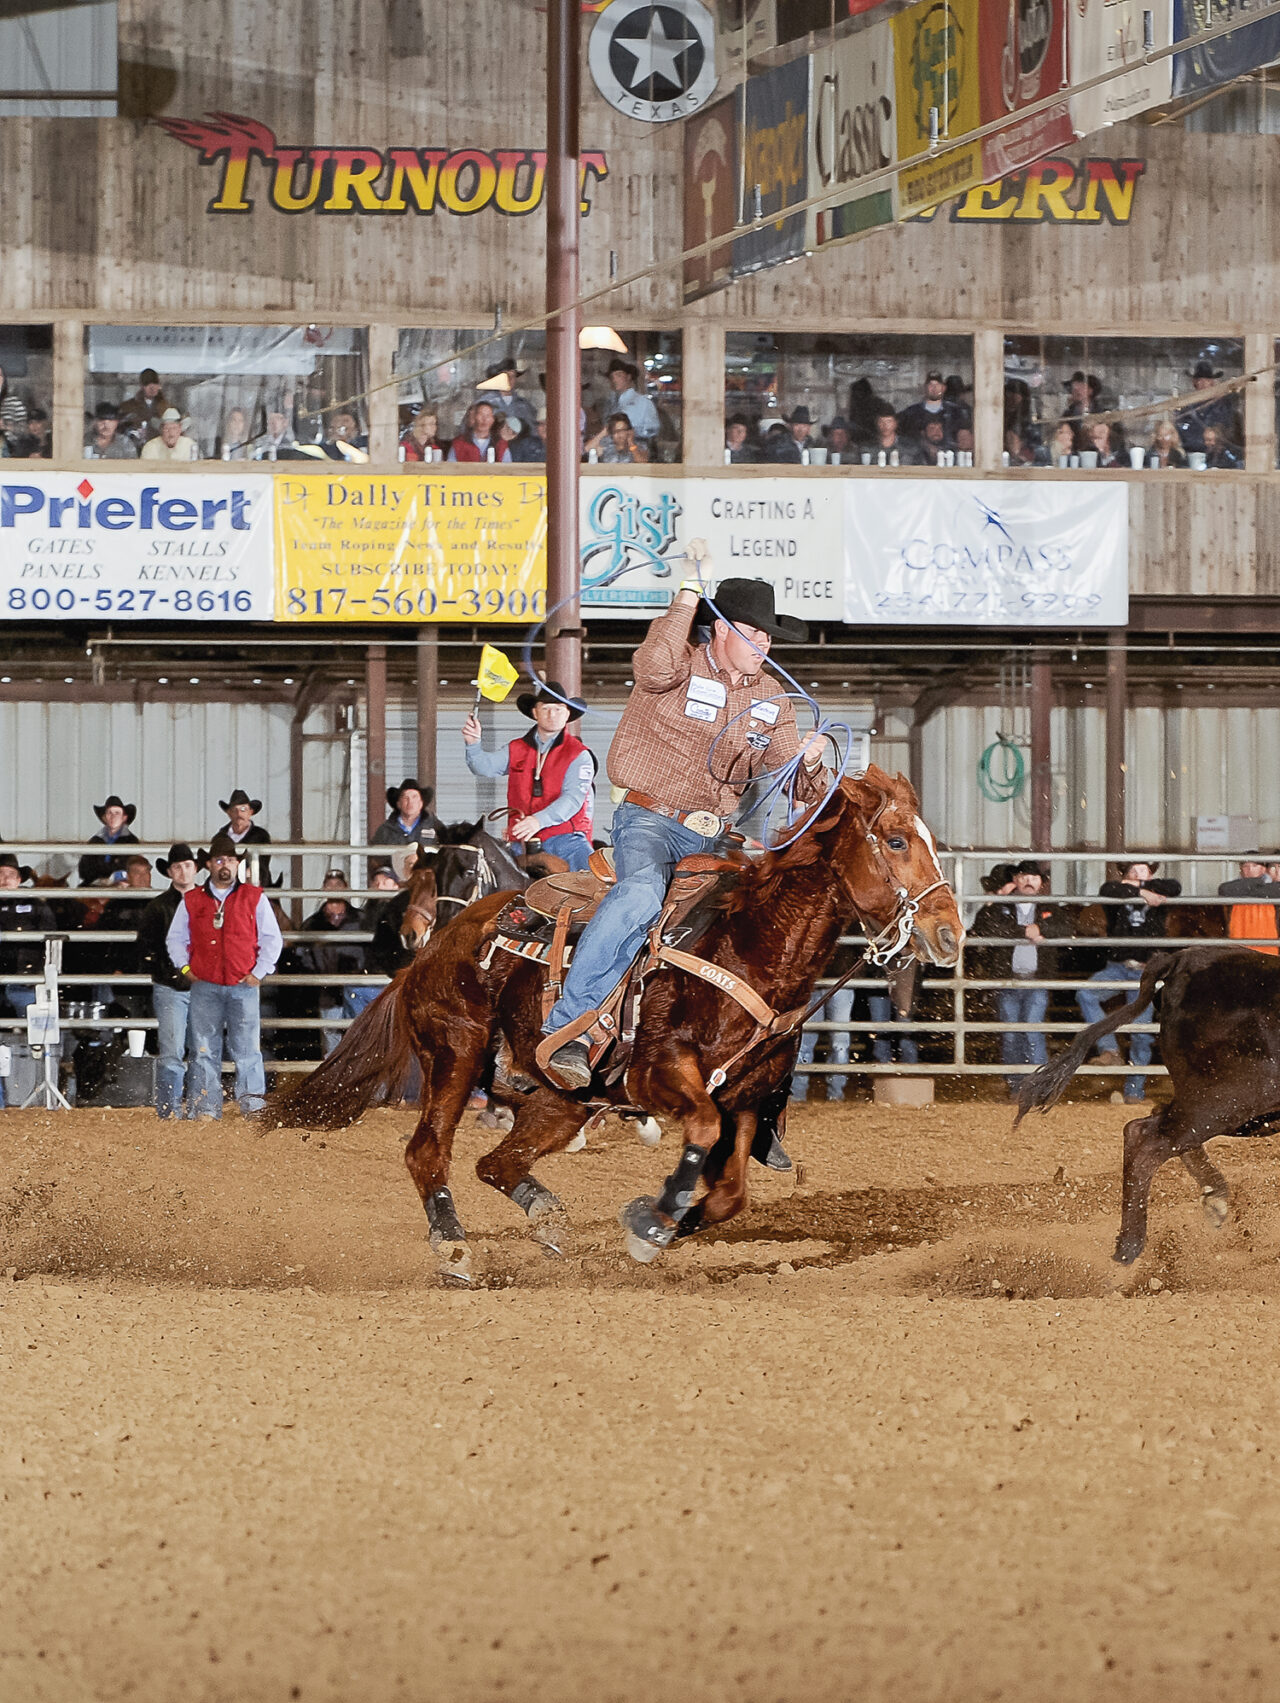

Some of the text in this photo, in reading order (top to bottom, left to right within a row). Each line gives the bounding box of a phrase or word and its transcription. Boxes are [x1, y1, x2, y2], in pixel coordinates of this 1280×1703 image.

[616, 91, 699, 117] TEXAS
[1, 478, 251, 530] Priefert
[327, 483, 405, 511] Dally
[417, 484, 504, 507] Times
[711, 497, 815, 520] CRAFTING A
[352, 516, 416, 531] Magazine
[420, 516, 441, 532] for
[446, 516, 468, 530] the
[28, 538, 229, 556] GATES STALLS
[341, 540, 395, 552] Roping
[450, 540, 478, 550] and
[580, 487, 682, 587] Gist
[730, 535, 797, 557] LEGEND
[902, 539, 1073, 571] COMPASS
[20, 563, 240, 580] PANELS KENNELS
[321, 562, 438, 576] SUBSCRIBE
[784, 577, 833, 599] PIECE
[8, 588, 253, 612] 800-527-8616
[287, 587, 547, 616] 817-560-3900
[700, 965, 736, 990] COATS
